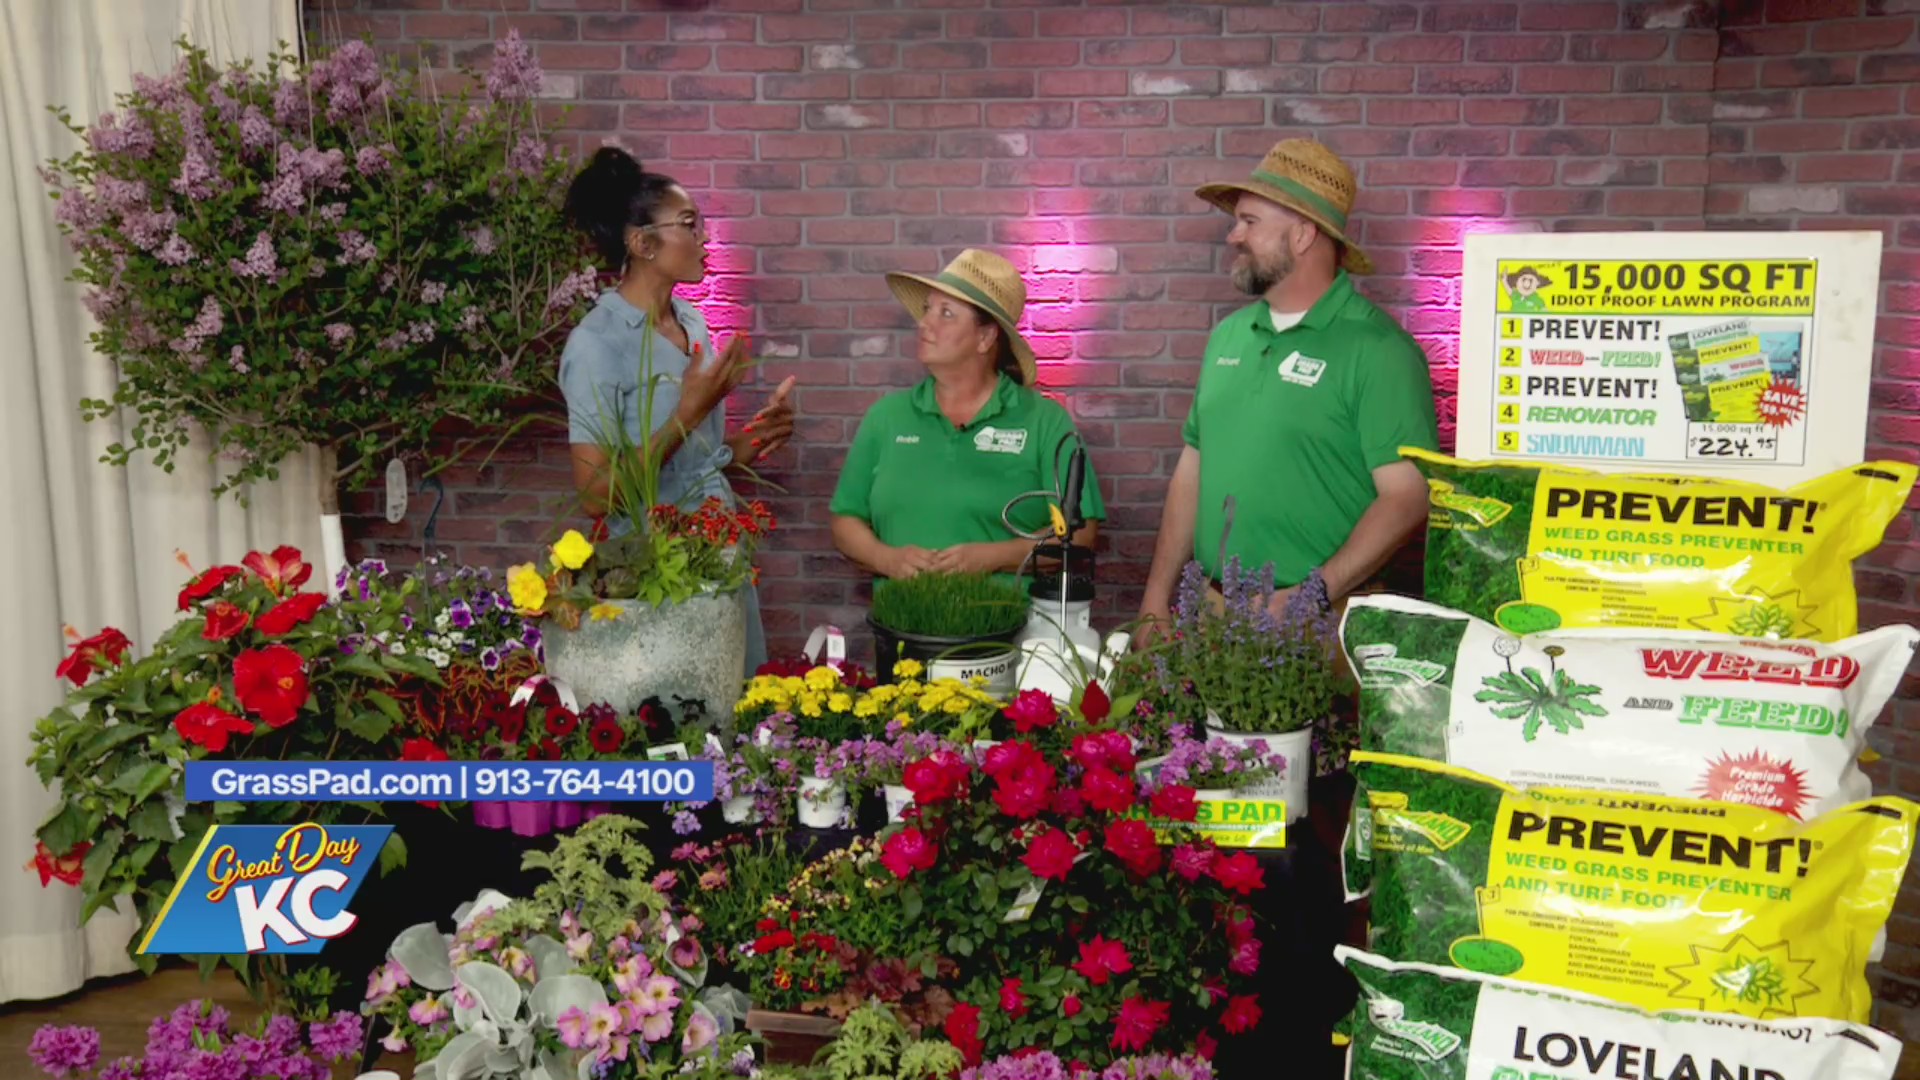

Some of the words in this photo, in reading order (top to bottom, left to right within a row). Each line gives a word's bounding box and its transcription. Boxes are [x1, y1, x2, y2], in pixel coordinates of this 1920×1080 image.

[1564, 264, 1685, 294] 15,000
[1699, 264, 1751, 293] SQ
[1765, 264, 1812, 290] FT
[1551, 295, 1595, 306] IDIOT
[1602, 295, 1657, 307] PROOF
[1662, 296, 1713, 307] LAWN
[1720, 296, 1810, 307] PROGRAM
[1507, 319, 1515, 333] 1
[1529, 319, 1660, 340] PREVENT!
[1505, 348, 1515, 361] 2
[1529, 349, 1585, 366] WEED
[1600, 351, 1662, 367] FEED!
[1504, 376, 1513, 390] 3
[1527, 376, 1658, 398] PREVENT!
[1503, 405, 1513, 418] 4
[1526, 406, 1657, 425] RENOVATOR
[1502, 433, 1512, 446] 5
[1527, 434, 1645, 457] SNOWMAN
[1546, 487, 1819, 534] PREVENT!
[1545, 527, 1599, 541] WEED
[1606, 529, 1673, 546] GRASS
[1681, 533, 1804, 555] PREVENTER
[1543, 546, 1583, 560] AND
[1590, 549, 1643, 566] TURF
[1649, 552, 1705, 569] FOOD
[961, 664, 1006, 679] MACHO
[1638, 647, 1861, 690] WEED
[1622, 697, 1674, 711] AND
[1678, 695, 1849, 739] FEED!
[1730, 766, 1786, 784] Premium
[1734, 779, 1776, 795] Grade
[1721, 790, 1784, 808] Herbicide
[1223, 802, 1282, 822] PAD
[1508, 810, 1812, 878] PREVENT!
[1506, 852, 1568, 872] WEED
[1574, 861, 1649, 882] GRASS
[1657, 871, 1792, 901] PREVENTER
[1503, 875, 1548, 892] AND
[1556, 881, 1615, 901] TURF
